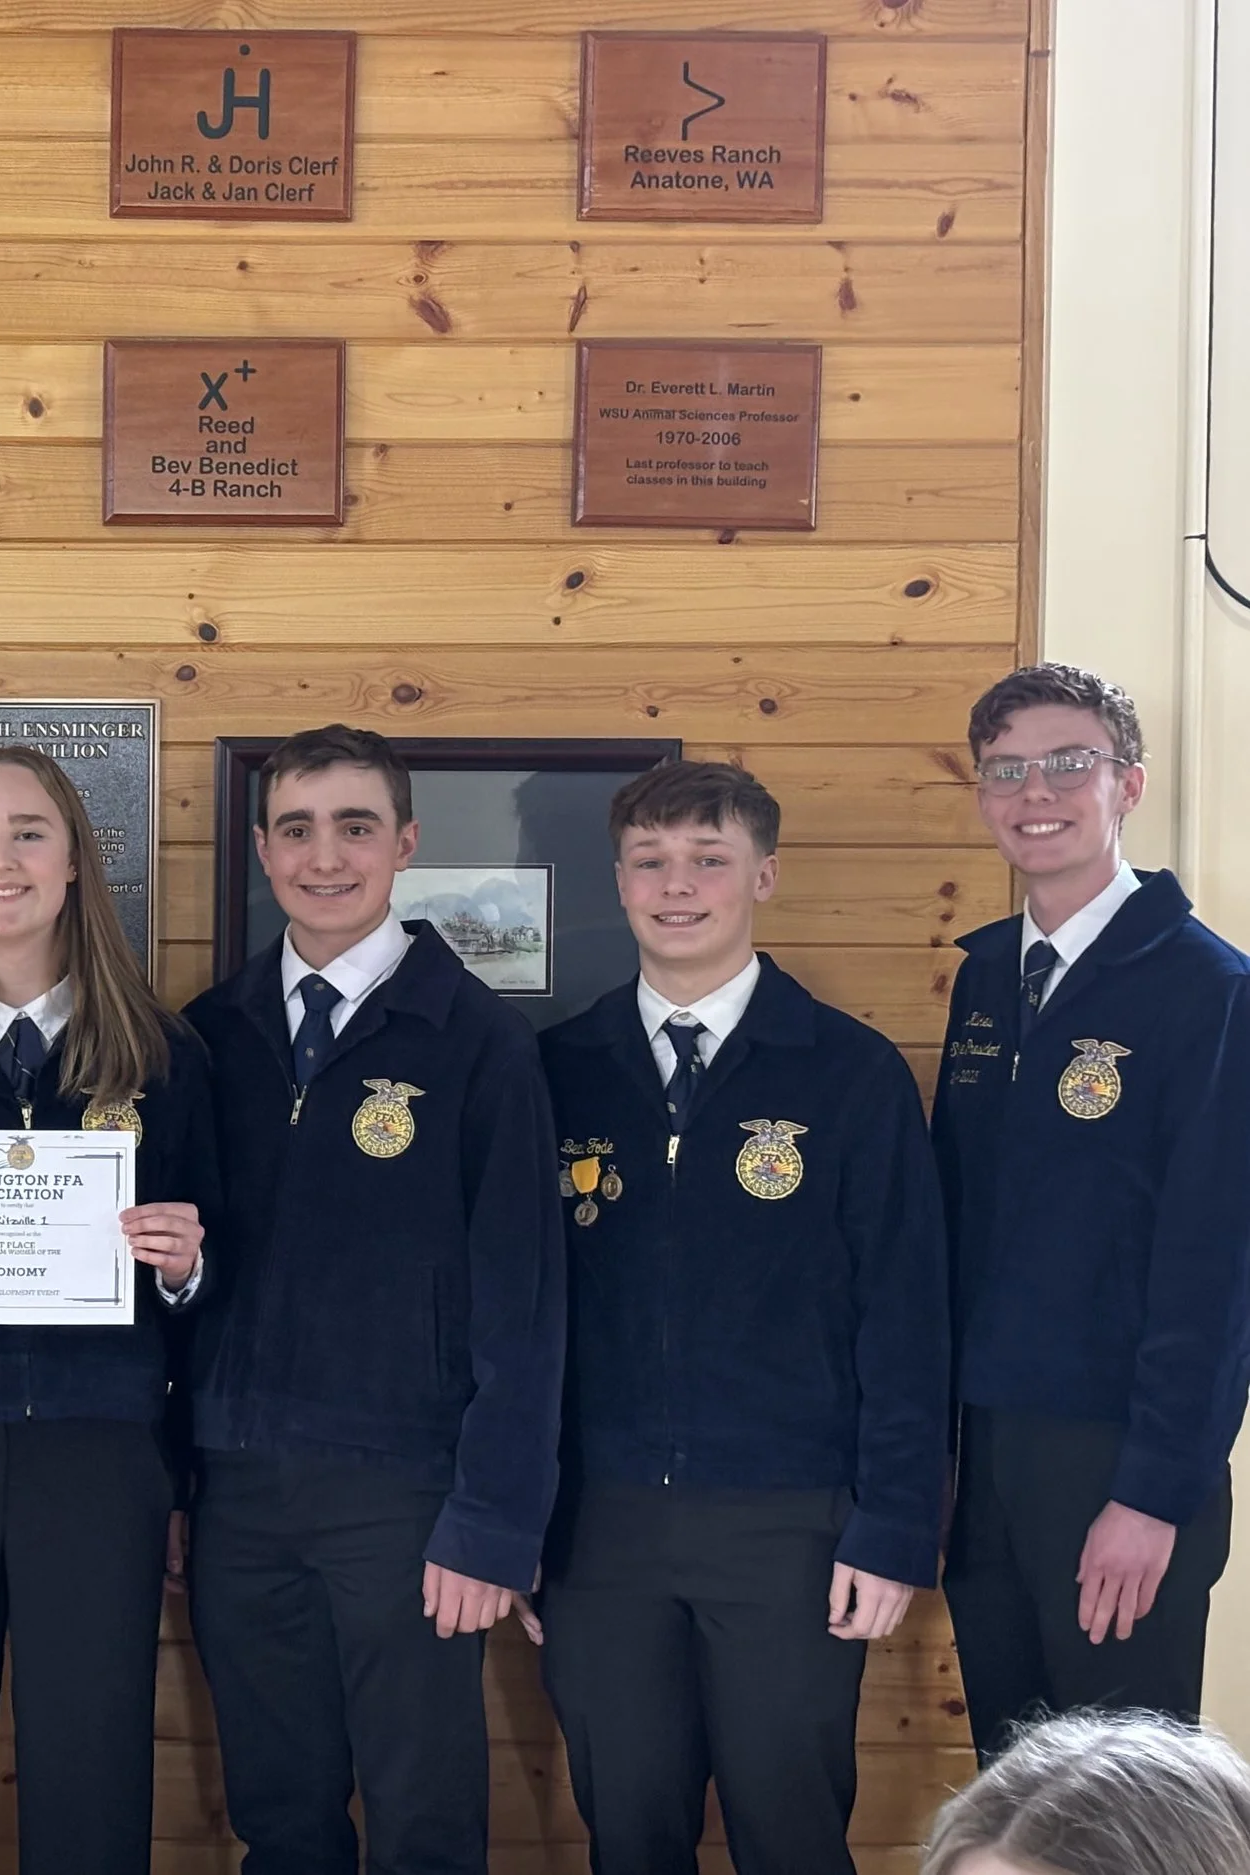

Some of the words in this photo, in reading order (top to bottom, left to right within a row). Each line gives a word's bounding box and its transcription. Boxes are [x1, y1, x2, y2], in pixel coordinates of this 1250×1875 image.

[624, 145, 704, 164] Reeves
[712, 145, 781, 164] Ranch
[125, 154, 174, 173] John
[181, 155, 200, 173] R.
[208, 155, 222, 174] &
[229, 155, 282, 174] Doris
[289, 156, 339, 176] Clerf
[630, 171, 729, 191] Anatone,
[736, 171, 774, 189] WA
[148, 181, 195, 200] Jack
[202, 182, 215, 200] &
[222, 182, 258, 201] Jan
[265, 182, 315, 202] Clerf
[626, 380, 646, 394] Dr.
[651, 381, 706, 395] Everett
[709, 383, 722, 395] L.
[727, 383, 775, 397] Martin
[599, 408, 629, 419] WSU
[632, 408, 676, 421] Animal
[679, 409, 735, 422] Sciences
[739, 411, 799, 423] Professor
[199, 415, 255, 434] Reed
[206, 437, 247, 454] and
[656, 431, 742, 446] 1970-2006
[151, 456, 192, 474] Bev
[199, 457, 299, 476] Benedict
[626, 458, 653, 470] Last
[656, 459, 715, 471] professor
[719, 460, 731, 471] to
[734, 460, 769, 471] teach
[168, 479, 206, 497] 4-B
[213, 480, 282, 498] Ranch
[626, 474, 673, 485] classes
[676, 475, 688, 486] in
[691, 475, 713, 486] this
[717, 475, 767, 489] building
[23, 722, 145, 738] ENSMINGER
[92, 828, 104, 838] of
[107, 828, 126, 838] the
[131, 884, 144, 893] of
[53, 1175, 83, 1186] FFA
[7, 1241, 35, 1249] PLACE
